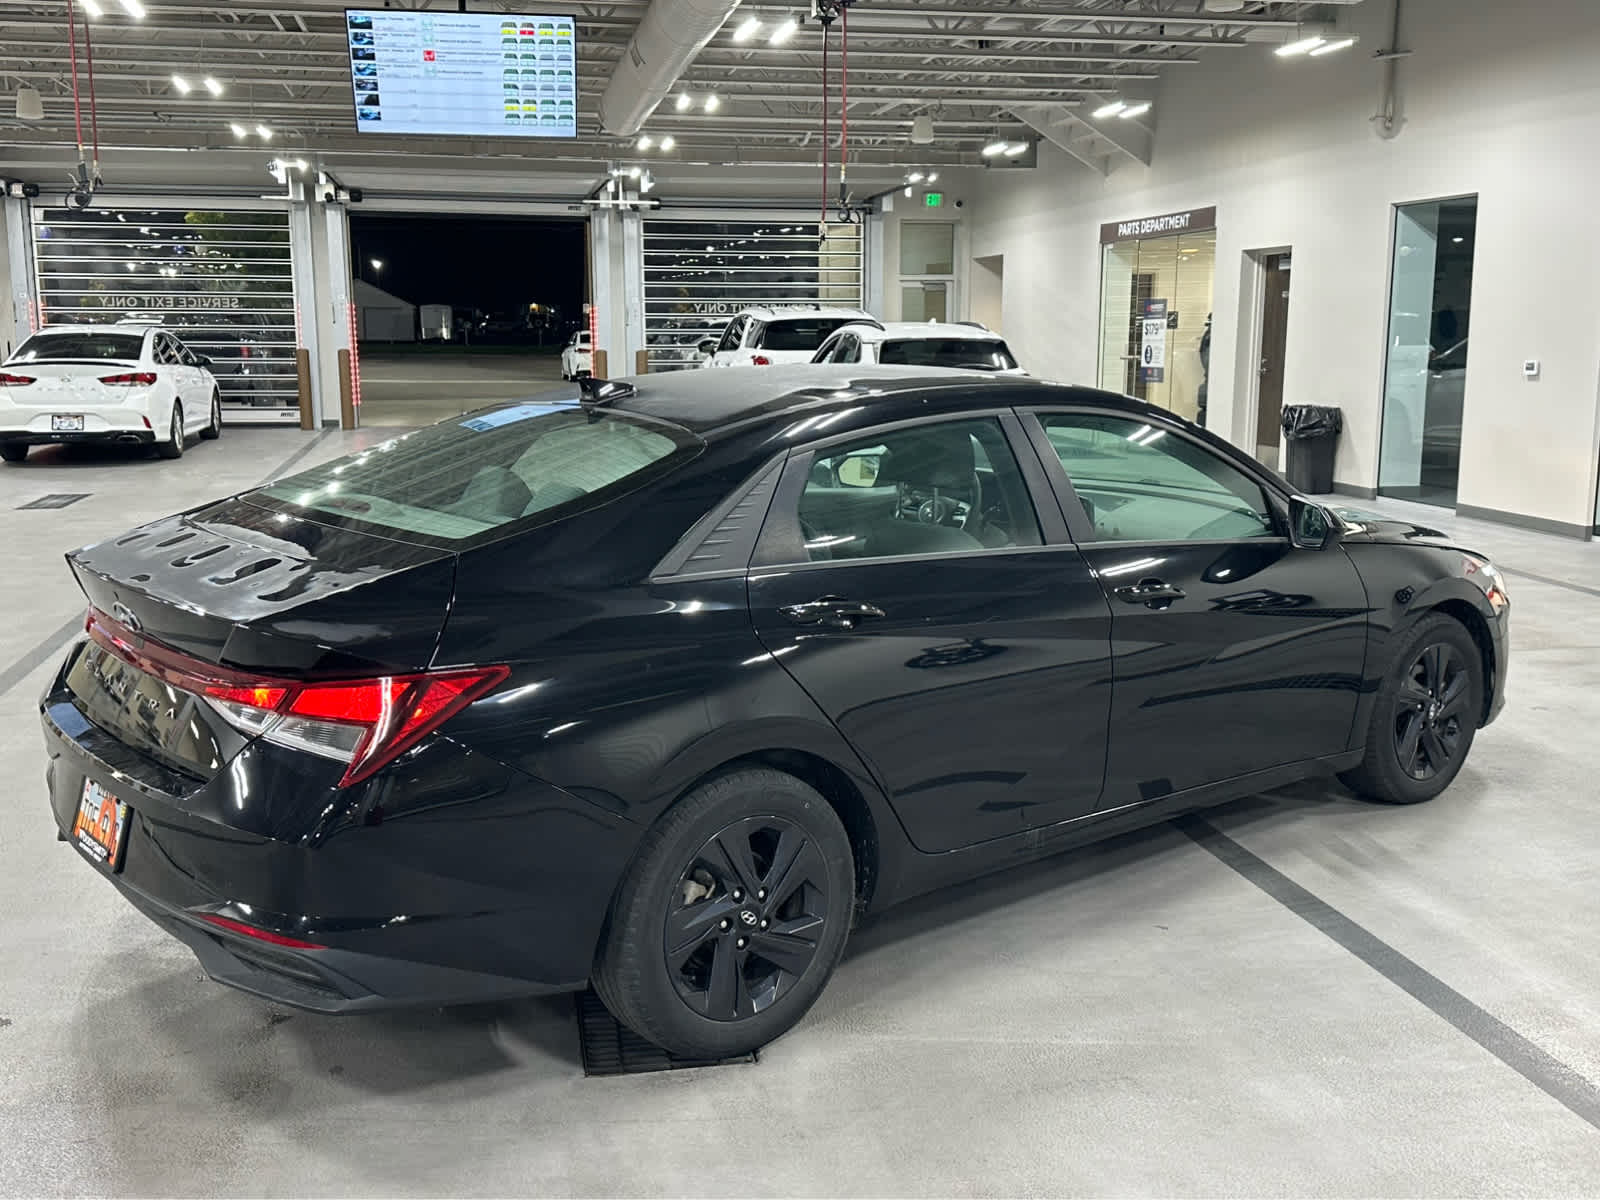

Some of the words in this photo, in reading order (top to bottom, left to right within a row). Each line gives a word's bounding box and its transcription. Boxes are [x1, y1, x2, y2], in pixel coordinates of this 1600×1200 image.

[1118, 221, 1140, 237] PARTS
[1140, 213, 1191, 234] DEPARTMENT
[85, 660, 176, 719] ELANTRA
